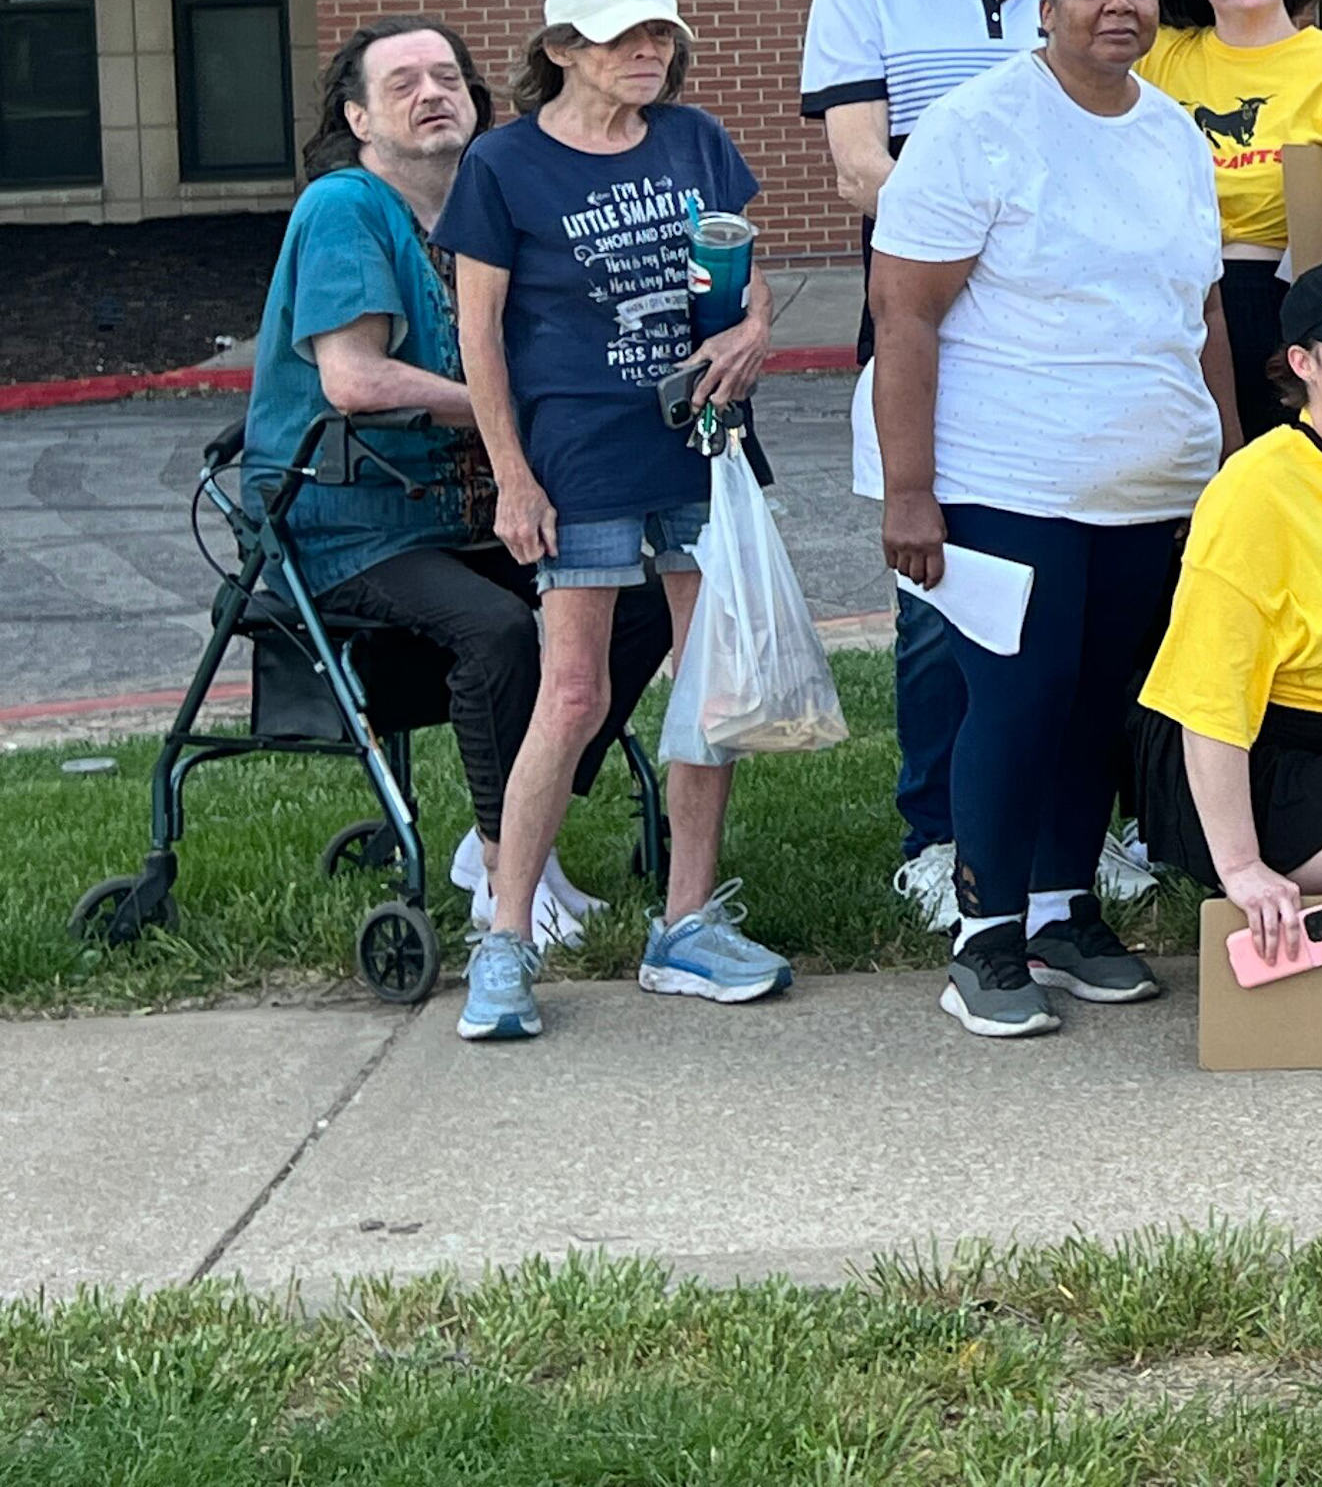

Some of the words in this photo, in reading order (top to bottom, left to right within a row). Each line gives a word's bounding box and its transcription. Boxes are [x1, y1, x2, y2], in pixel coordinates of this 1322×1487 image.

[611, 182, 639, 203] I'M
[643, 177, 655, 196] A
[562, 205, 620, 239] LITTLE
[619, 192, 676, 226] SMART
[635, 227, 659, 245] AND
[607, 346, 647, 366] PISS
[621, 366, 646, 381] I'LL
